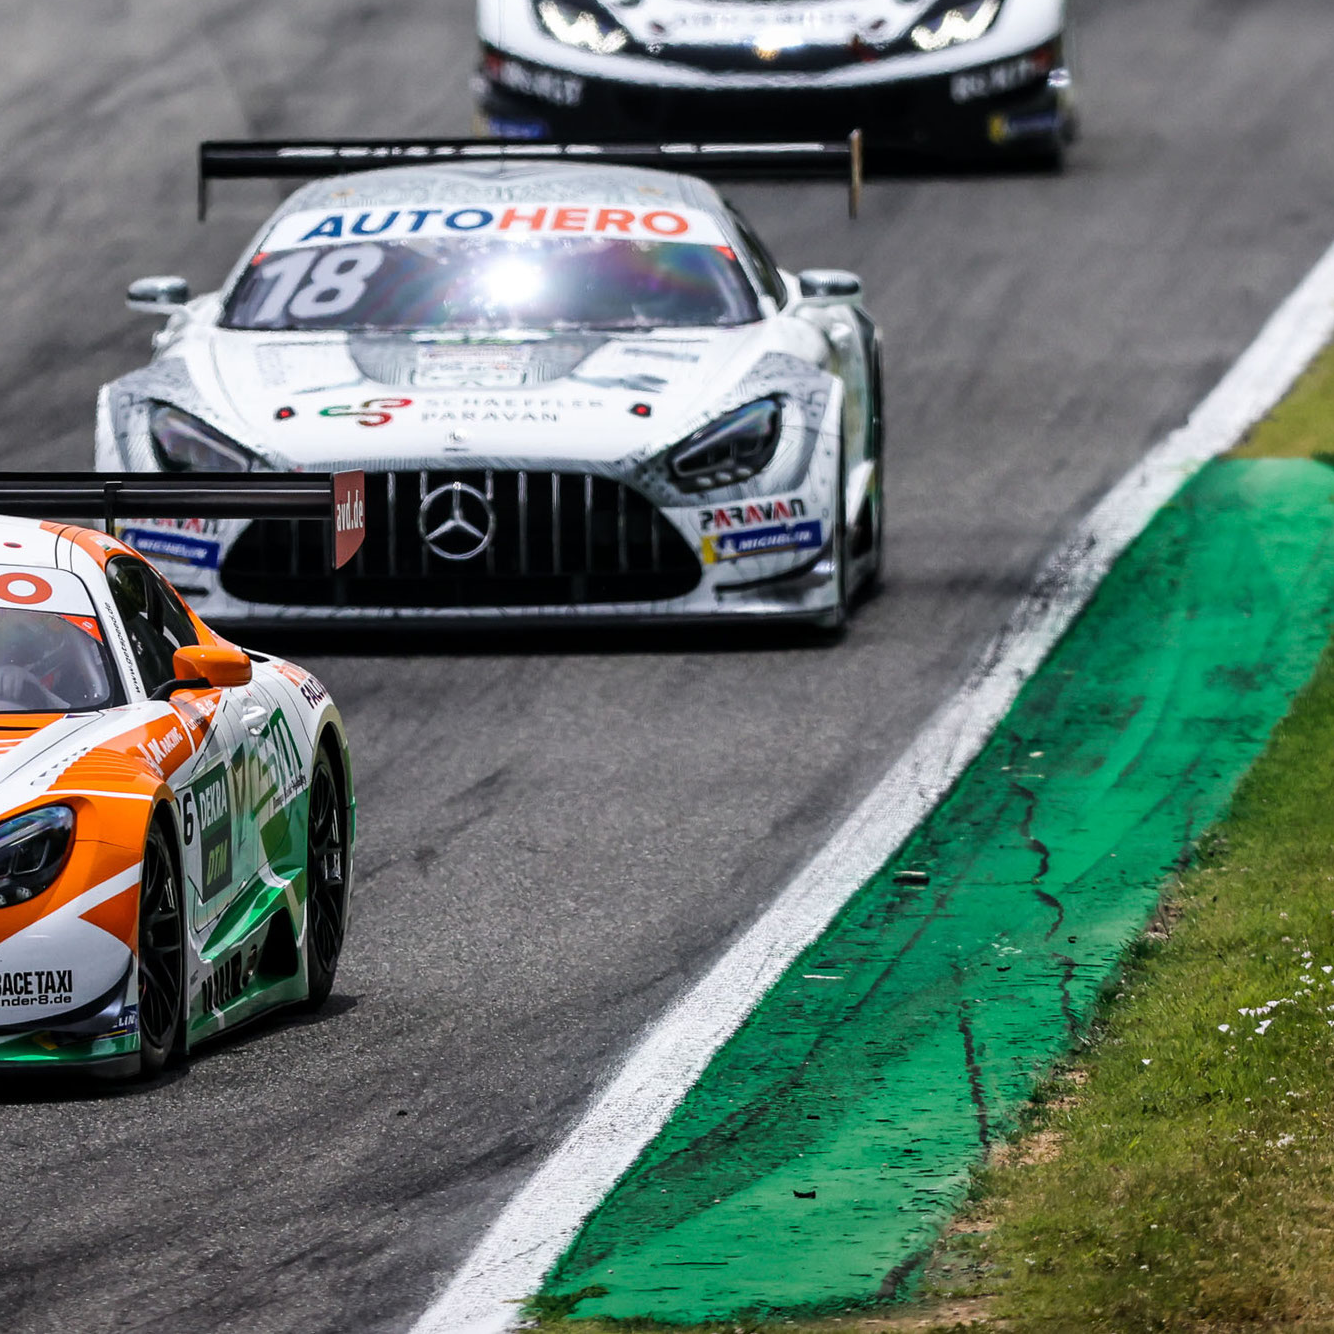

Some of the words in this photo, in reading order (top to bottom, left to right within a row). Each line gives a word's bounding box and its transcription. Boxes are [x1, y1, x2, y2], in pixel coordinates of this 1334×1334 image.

[300, 206, 690, 242] AUTOHERO
[255, 243, 385, 322] 18
[421, 411, 559, 423] PARAVAN
[336, 489, 364, 532] avd.de
[700, 498, 805, 529] PARAVAN
[199, 775, 228, 832] DEKRA
[206, 838, 228, 886] DTM
